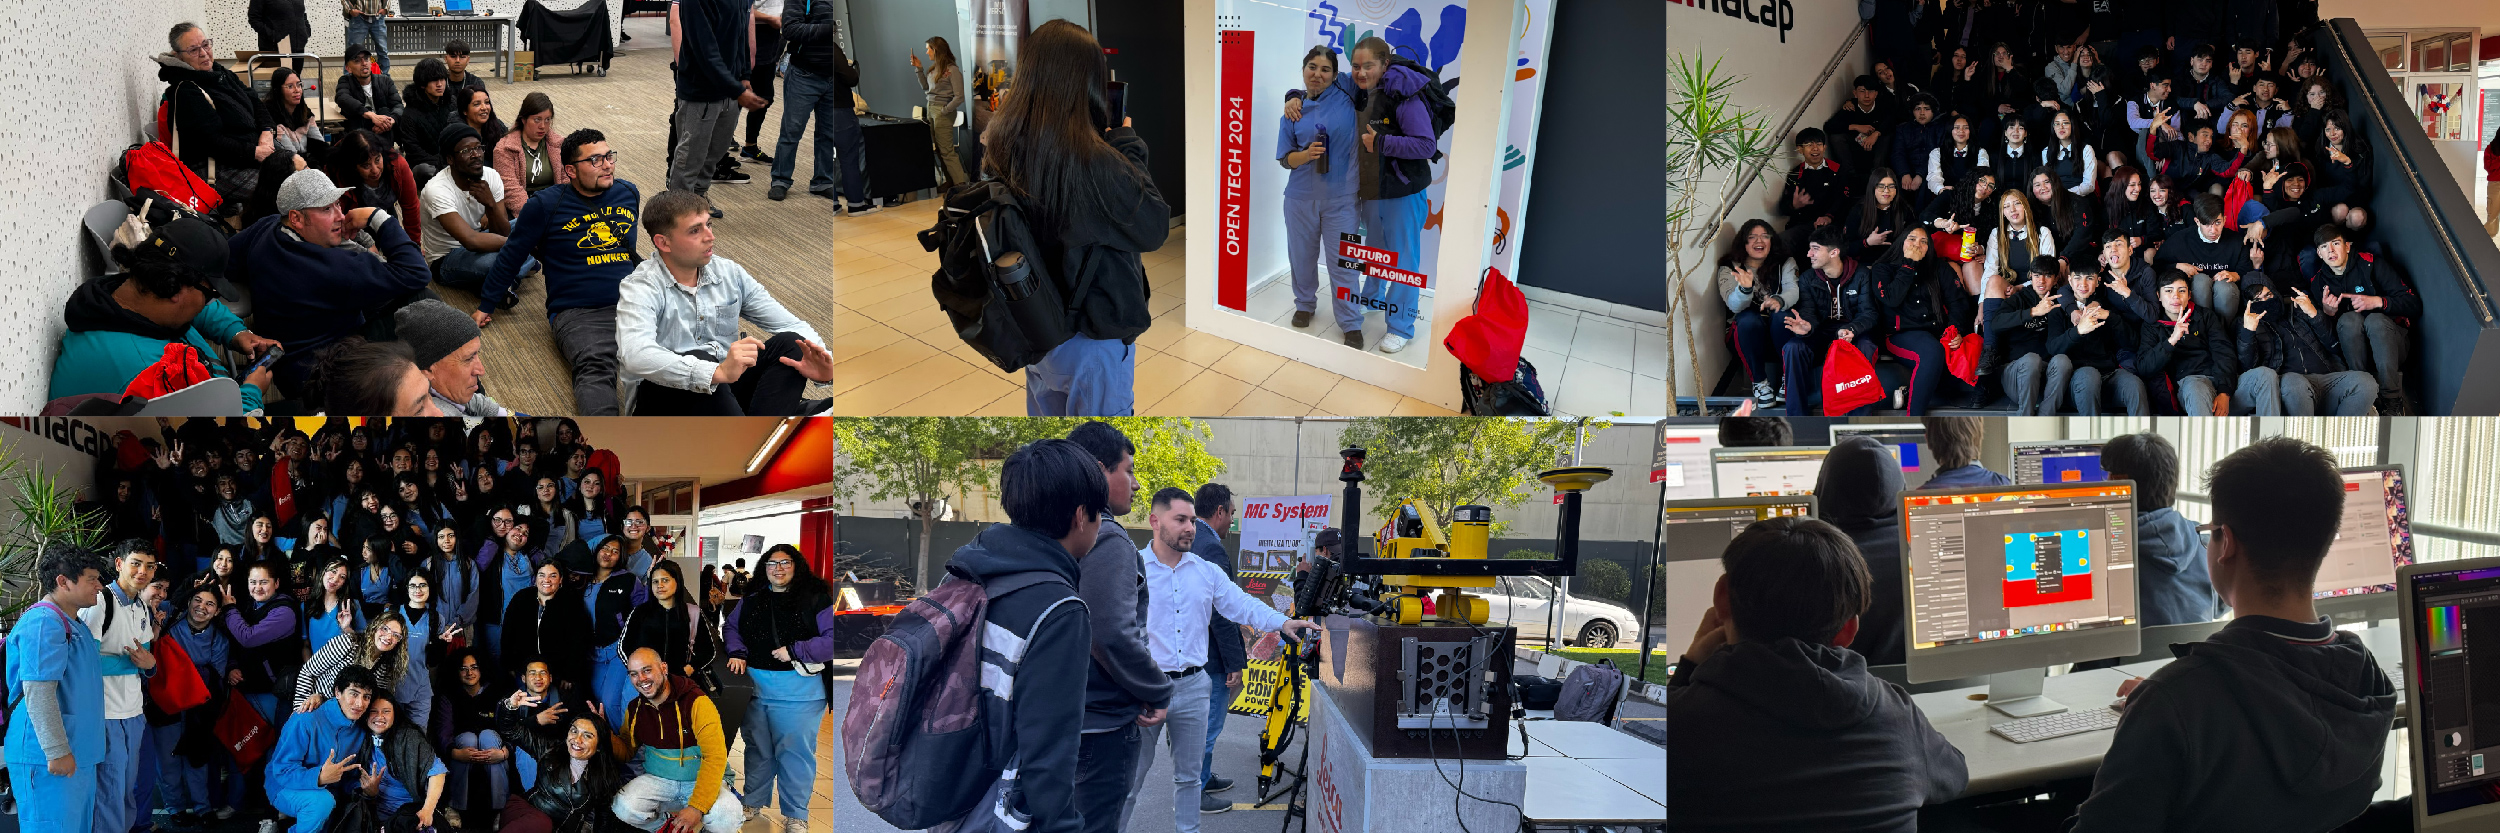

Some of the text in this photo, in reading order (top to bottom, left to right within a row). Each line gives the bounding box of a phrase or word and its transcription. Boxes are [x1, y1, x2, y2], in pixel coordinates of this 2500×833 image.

[1227, 96, 1243, 256] OPEN TECH 2024
[562, 218, 580, 231] THE
[1347, 246, 1391, 263] FUTURO
[1369, 266, 1422, 286] IMAGINAS
[1244, 503, 1328, 522] MC System
[1246, 578, 1266, 589] Leica
